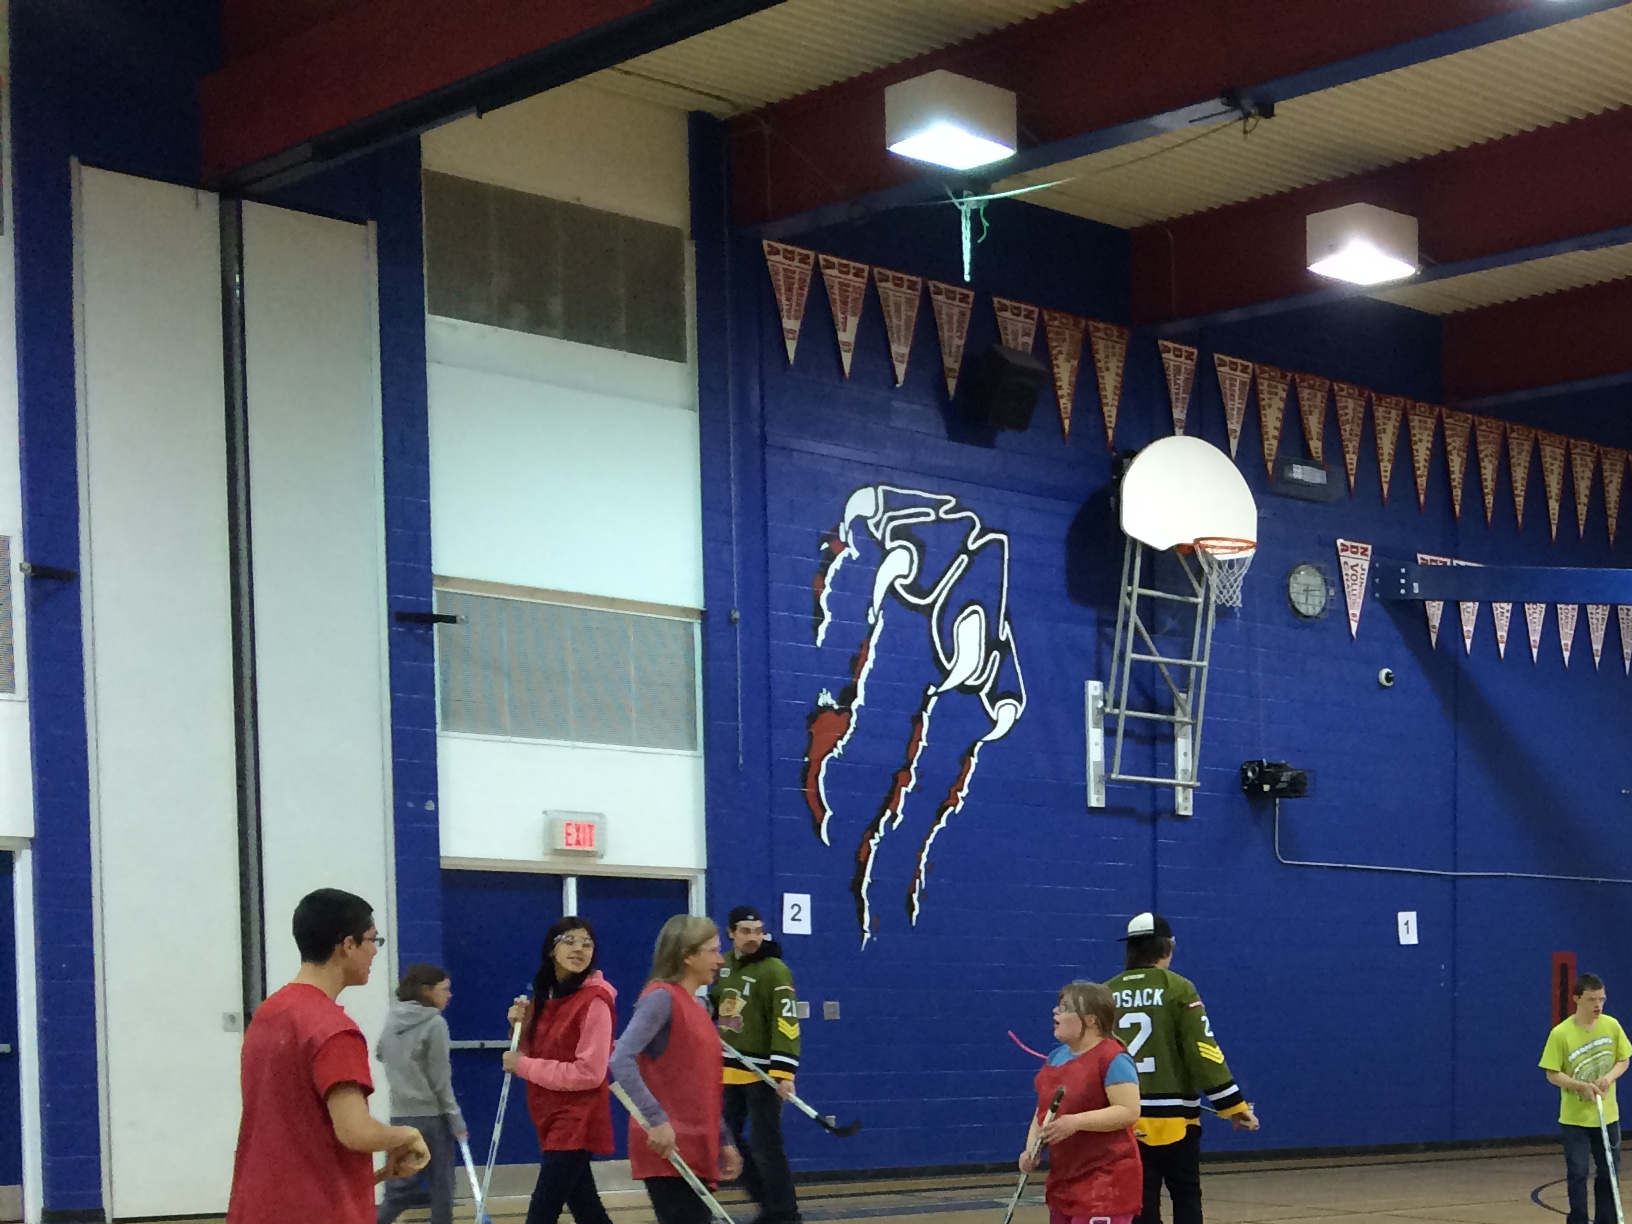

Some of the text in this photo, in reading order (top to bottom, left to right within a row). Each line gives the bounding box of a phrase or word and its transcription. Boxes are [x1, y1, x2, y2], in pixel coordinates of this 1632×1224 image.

[1341, 543, 1369, 558] NDA
[564, 821, 595, 849] EXIT
[790, 903, 802, 922] 2
[1403, 919, 1411, 935] 1
[780, 998, 798, 1017] 21
[1200, 1015, 1214, 1037] 2
[1118, 1012, 1156, 1073] 2
